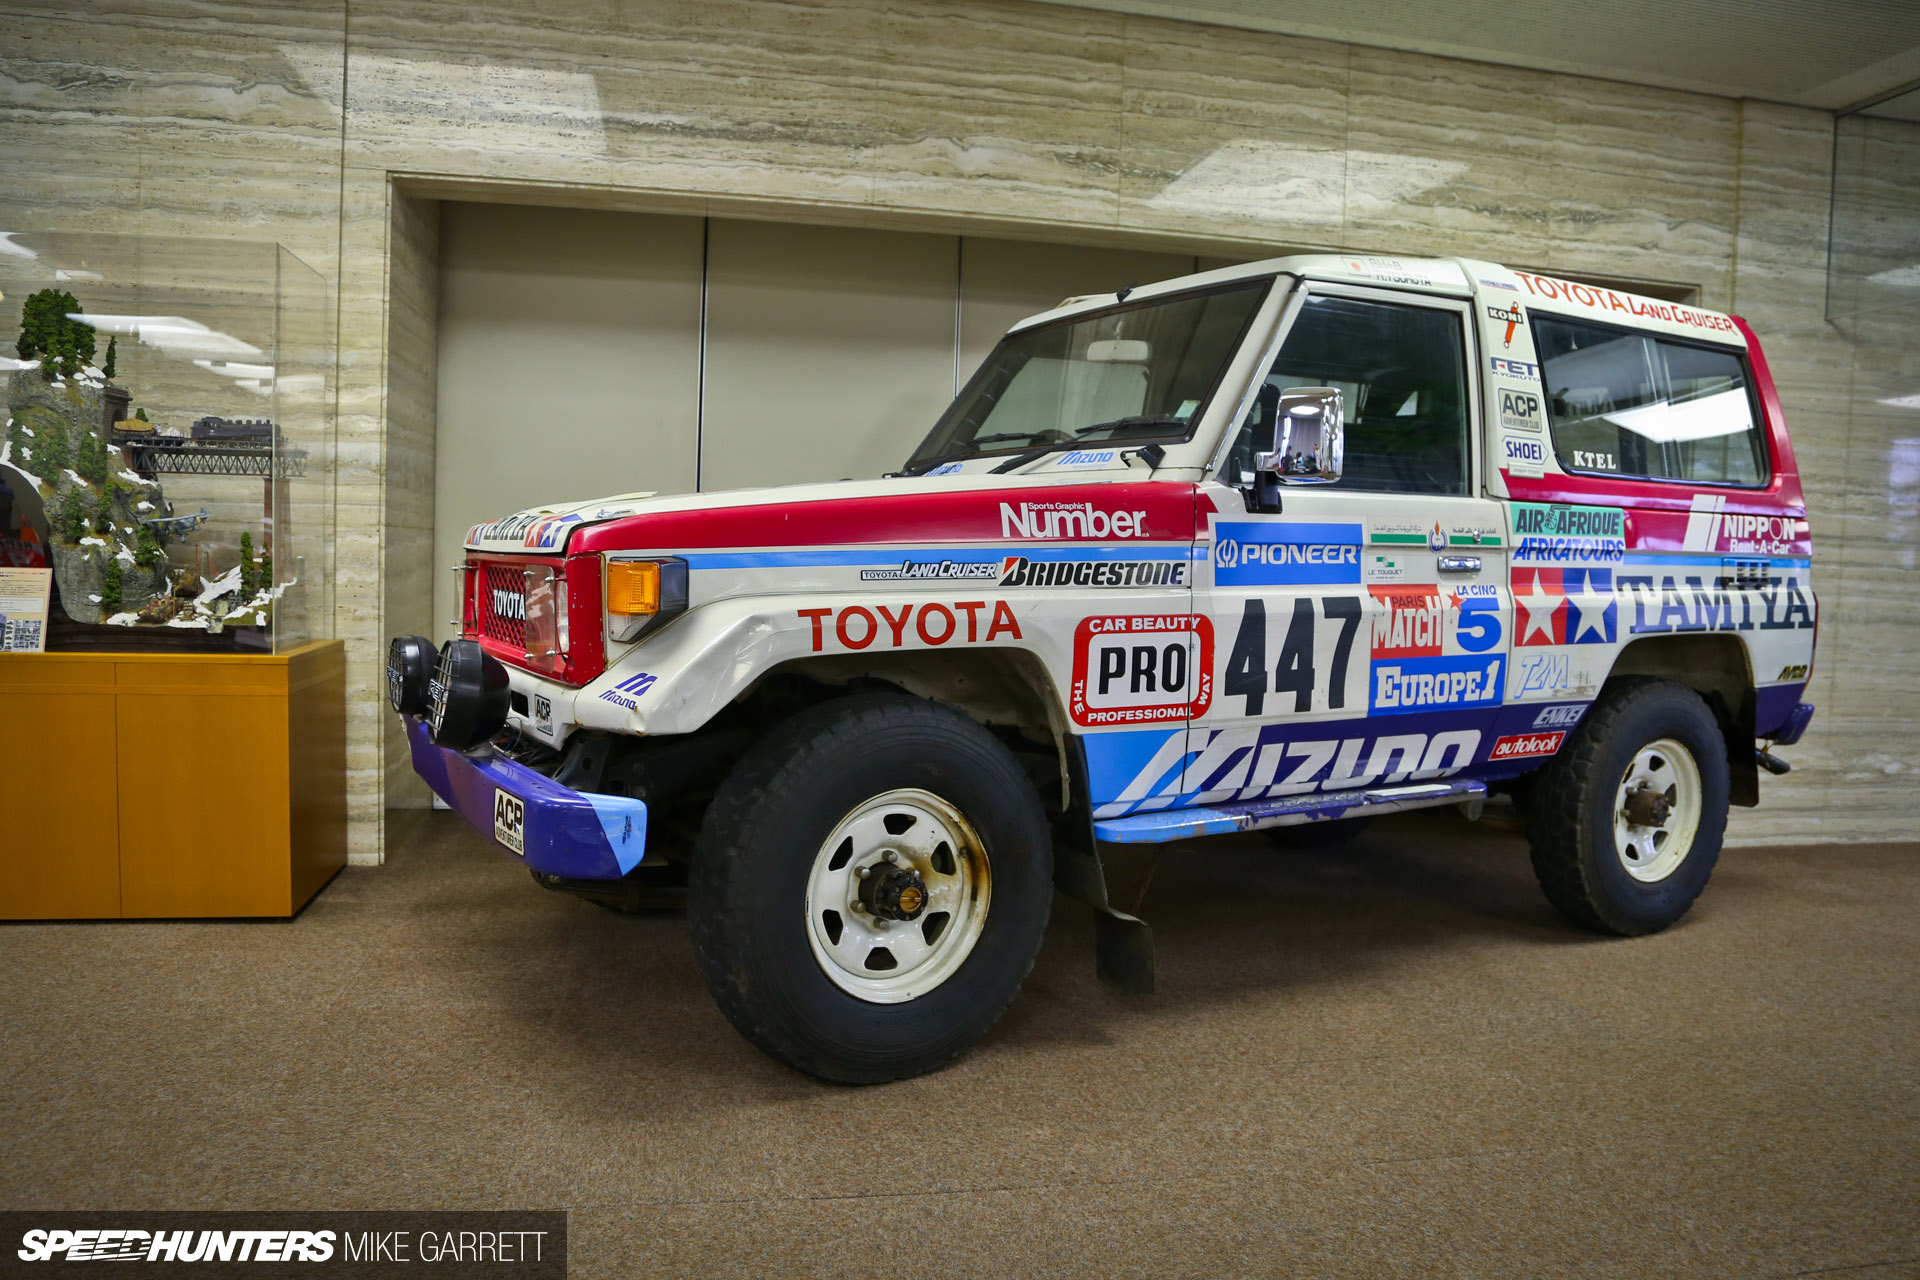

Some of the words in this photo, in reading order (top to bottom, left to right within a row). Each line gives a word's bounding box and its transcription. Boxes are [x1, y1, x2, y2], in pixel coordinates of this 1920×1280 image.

[1488, 308, 1522, 322] KONI
[1515, 272, 1629, 313] TOYOTA
[1627, 296, 1671, 321] LAND
[1671, 305, 1738, 335] CRUISER
[1492, 371, 1540, 382] KYOKUTO
[1503, 393, 1538, 417] ACP
[1506, 441, 1542, 460] SHOEI
[1573, 450, 1617, 470] KTEL
[1028, 502, 1054, 511] Sports
[1055, 502, 1085, 511] Graphic
[1516, 509, 1545, 533] AIR
[1556, 511, 1620, 535] AFRIQUE
[1724, 515, 1796, 540] NIPPON
[1242, 544, 1358, 565] PIONEER
[1513, 537, 1625, 561] AFRICATOURS
[1730, 539, 1790, 554] Rent-A-Car
[864, 570, 898, 578] TOYOTA
[999, 557, 1186, 587] BRIDGESTONE
[1391, 596, 1425, 608] PARIS
[1457, 585, 1469, 595] LA
[1471, 585, 1497, 596] CINQ
[494, 589, 526, 620] TOYOTA
[1616, 576, 1814, 634] TAMIYA
[797, 600, 1023, 651] TOYOTA
[1089, 618, 1126, 633] CAR
[1132, 617, 1201, 631] BEAUTY
[1372, 596, 1442, 649] MATCH
[1456, 598, 1502, 652] 5
[1225, 596, 1362, 716] 447
[1098, 643, 1187, 695] PRO
[1514, 652, 1568, 699] T2M
[536, 698, 551, 722] ACP
[1073, 679, 1085, 715] THE
[1087, 707, 1194, 723] PROFESSIONAL
[1198, 673, 1211, 705] WAY
[1533, 704, 1588, 725] ENKEI
[1496, 735, 1559, 755] autolook
[496, 794, 522, 835] ACP
